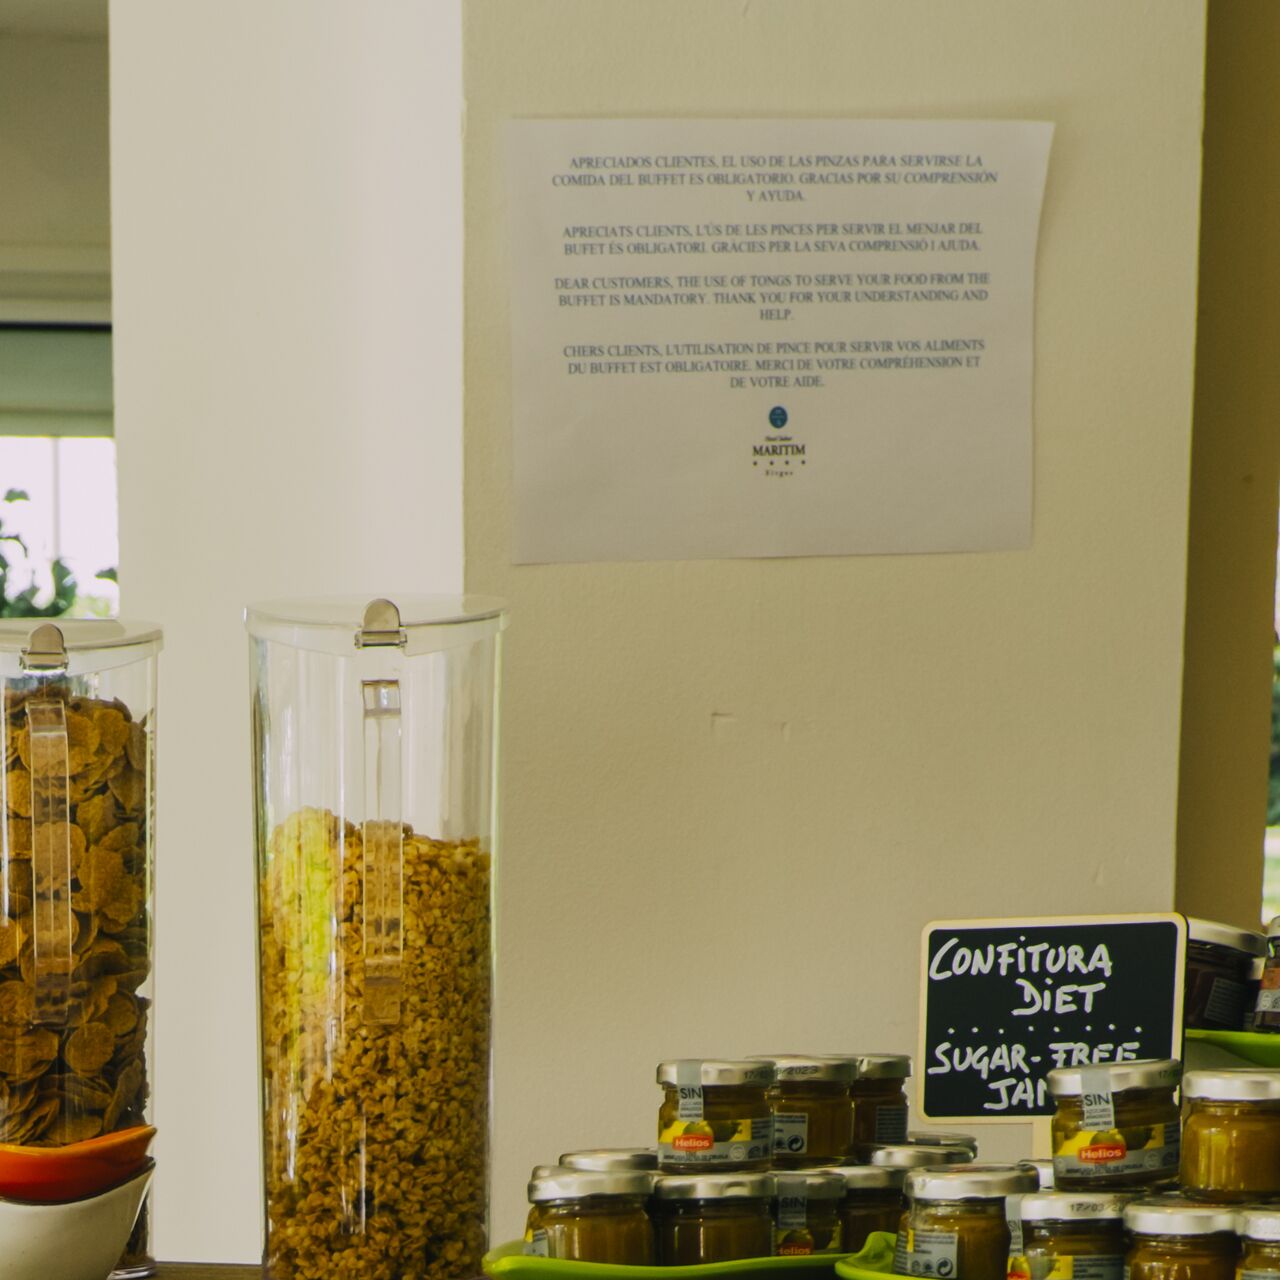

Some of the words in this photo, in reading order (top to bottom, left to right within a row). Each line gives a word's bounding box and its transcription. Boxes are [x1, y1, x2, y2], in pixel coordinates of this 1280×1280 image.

[722, 156, 736, 167] EL
[741, 156, 766, 167] USO
[770, 156, 784, 167] DE
[789, 156, 812, 167] LAS
[816, 156, 859, 167] PINZAS
[863, 155, 896, 166] PARA
[966, 155, 982, 166] LA
[552, 174, 606, 185] COMIDA
[610, 174, 634, 185] DEL
[638, 174, 685, 185] BUFFET
[689, 174, 704, 185] ES
[800, 173, 854, 184] GRACIAS
[857, 173, 880, 184] POR
[885, 173, 900, 184] SU
[746, 191, 755, 202] Y
[725, 225, 740, 236] DE
[745, 225, 767, 236] LES
[771, 224, 813, 235] PINCES
[817, 224, 838, 235] PER
[842, 224, 885, 235] SERVIR
[889, 224, 903, 235] EL
[906, 223, 956, 234] MENJAR
[959, 223, 983, 234] DEL
[565, 243, 605, 254] BUFET
[770, 242, 791, 253] PER
[795, 242, 811, 253] LA
[815, 241, 846, 252] SEVA
[931, 240, 935, 251] I
[555, 278, 590, 289] DEAR
[678, 277, 701, 288] THE
[704, 276, 727, 287] USE
[731, 276, 747, 287] OF
[750, 276, 791, 287] TONGS
[795, 275, 812, 286] TO
[815, 275, 853, 286] SERVE
[857, 275, 891, 286] YOUR
[894, 274, 927, 285] FOOD
[930, 274, 964, 285] FROM
[967, 274, 990, 285] THE
[559, 295, 606, 306] BUFFET
[610, 294, 620, 305] IS
[714, 293, 755, 304] THANK
[760, 293, 788, 304] YOU
[790, 292, 813, 303] FOR
[817, 292, 851, 303] YOUR
[962, 290, 988, 301] AND
[564, 345, 604, 356] CHERS
[757, 343, 775, 354] DE
[776, 343, 810, 354] PINCE
[815, 342, 846, 353] POUR
[850, 341, 893, 352] SERVIR
[897, 341, 921, 352] VOS
[568, 362, 587, 373] DU
[590, 362, 636, 373] BUFFET
[640, 361, 661, 372] EST
[755, 360, 794, 371] MERCI
[797, 359, 812, 370] DE
[817, 359, 856, 370] VOTRE
[966, 357, 980, 368] ET
[730, 376, 745, 387] DE
[750, 376, 790, 387] VOTRE
[752, 444, 806, 456] MARITIM
[680, 1087, 703, 1099] SIN
[1084, 1093, 1110, 1106] SIN
[675, 1138, 710, 1147] Helios
[1080, 1148, 1122, 1159] Helios
